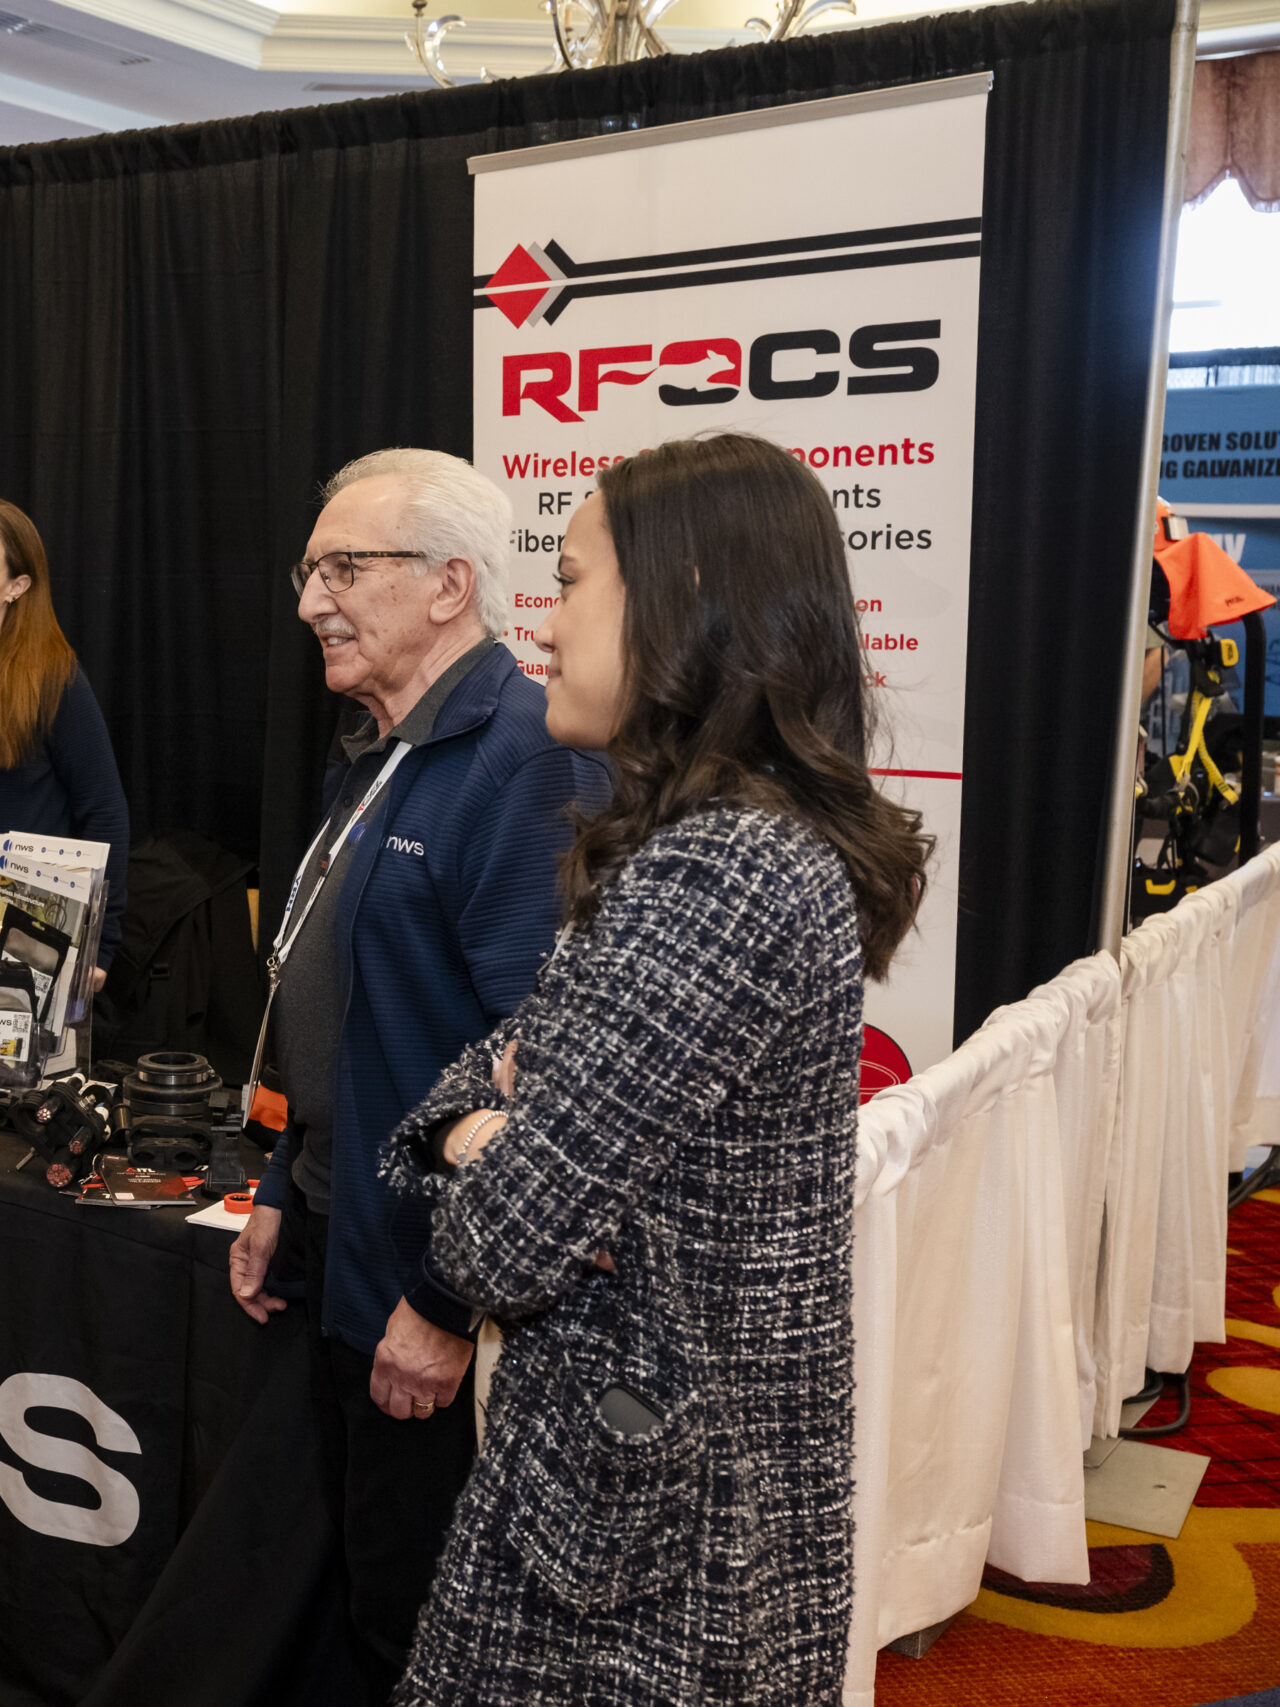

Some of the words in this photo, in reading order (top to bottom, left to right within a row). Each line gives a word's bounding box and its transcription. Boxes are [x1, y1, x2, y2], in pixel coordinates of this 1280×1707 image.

[538, 491, 572, 515] RF
[843, 524, 933, 550] ories
[14, 843, 34, 853] nws
[386, 835, 425, 857] nws
[10, 861, 29, 874] nws
